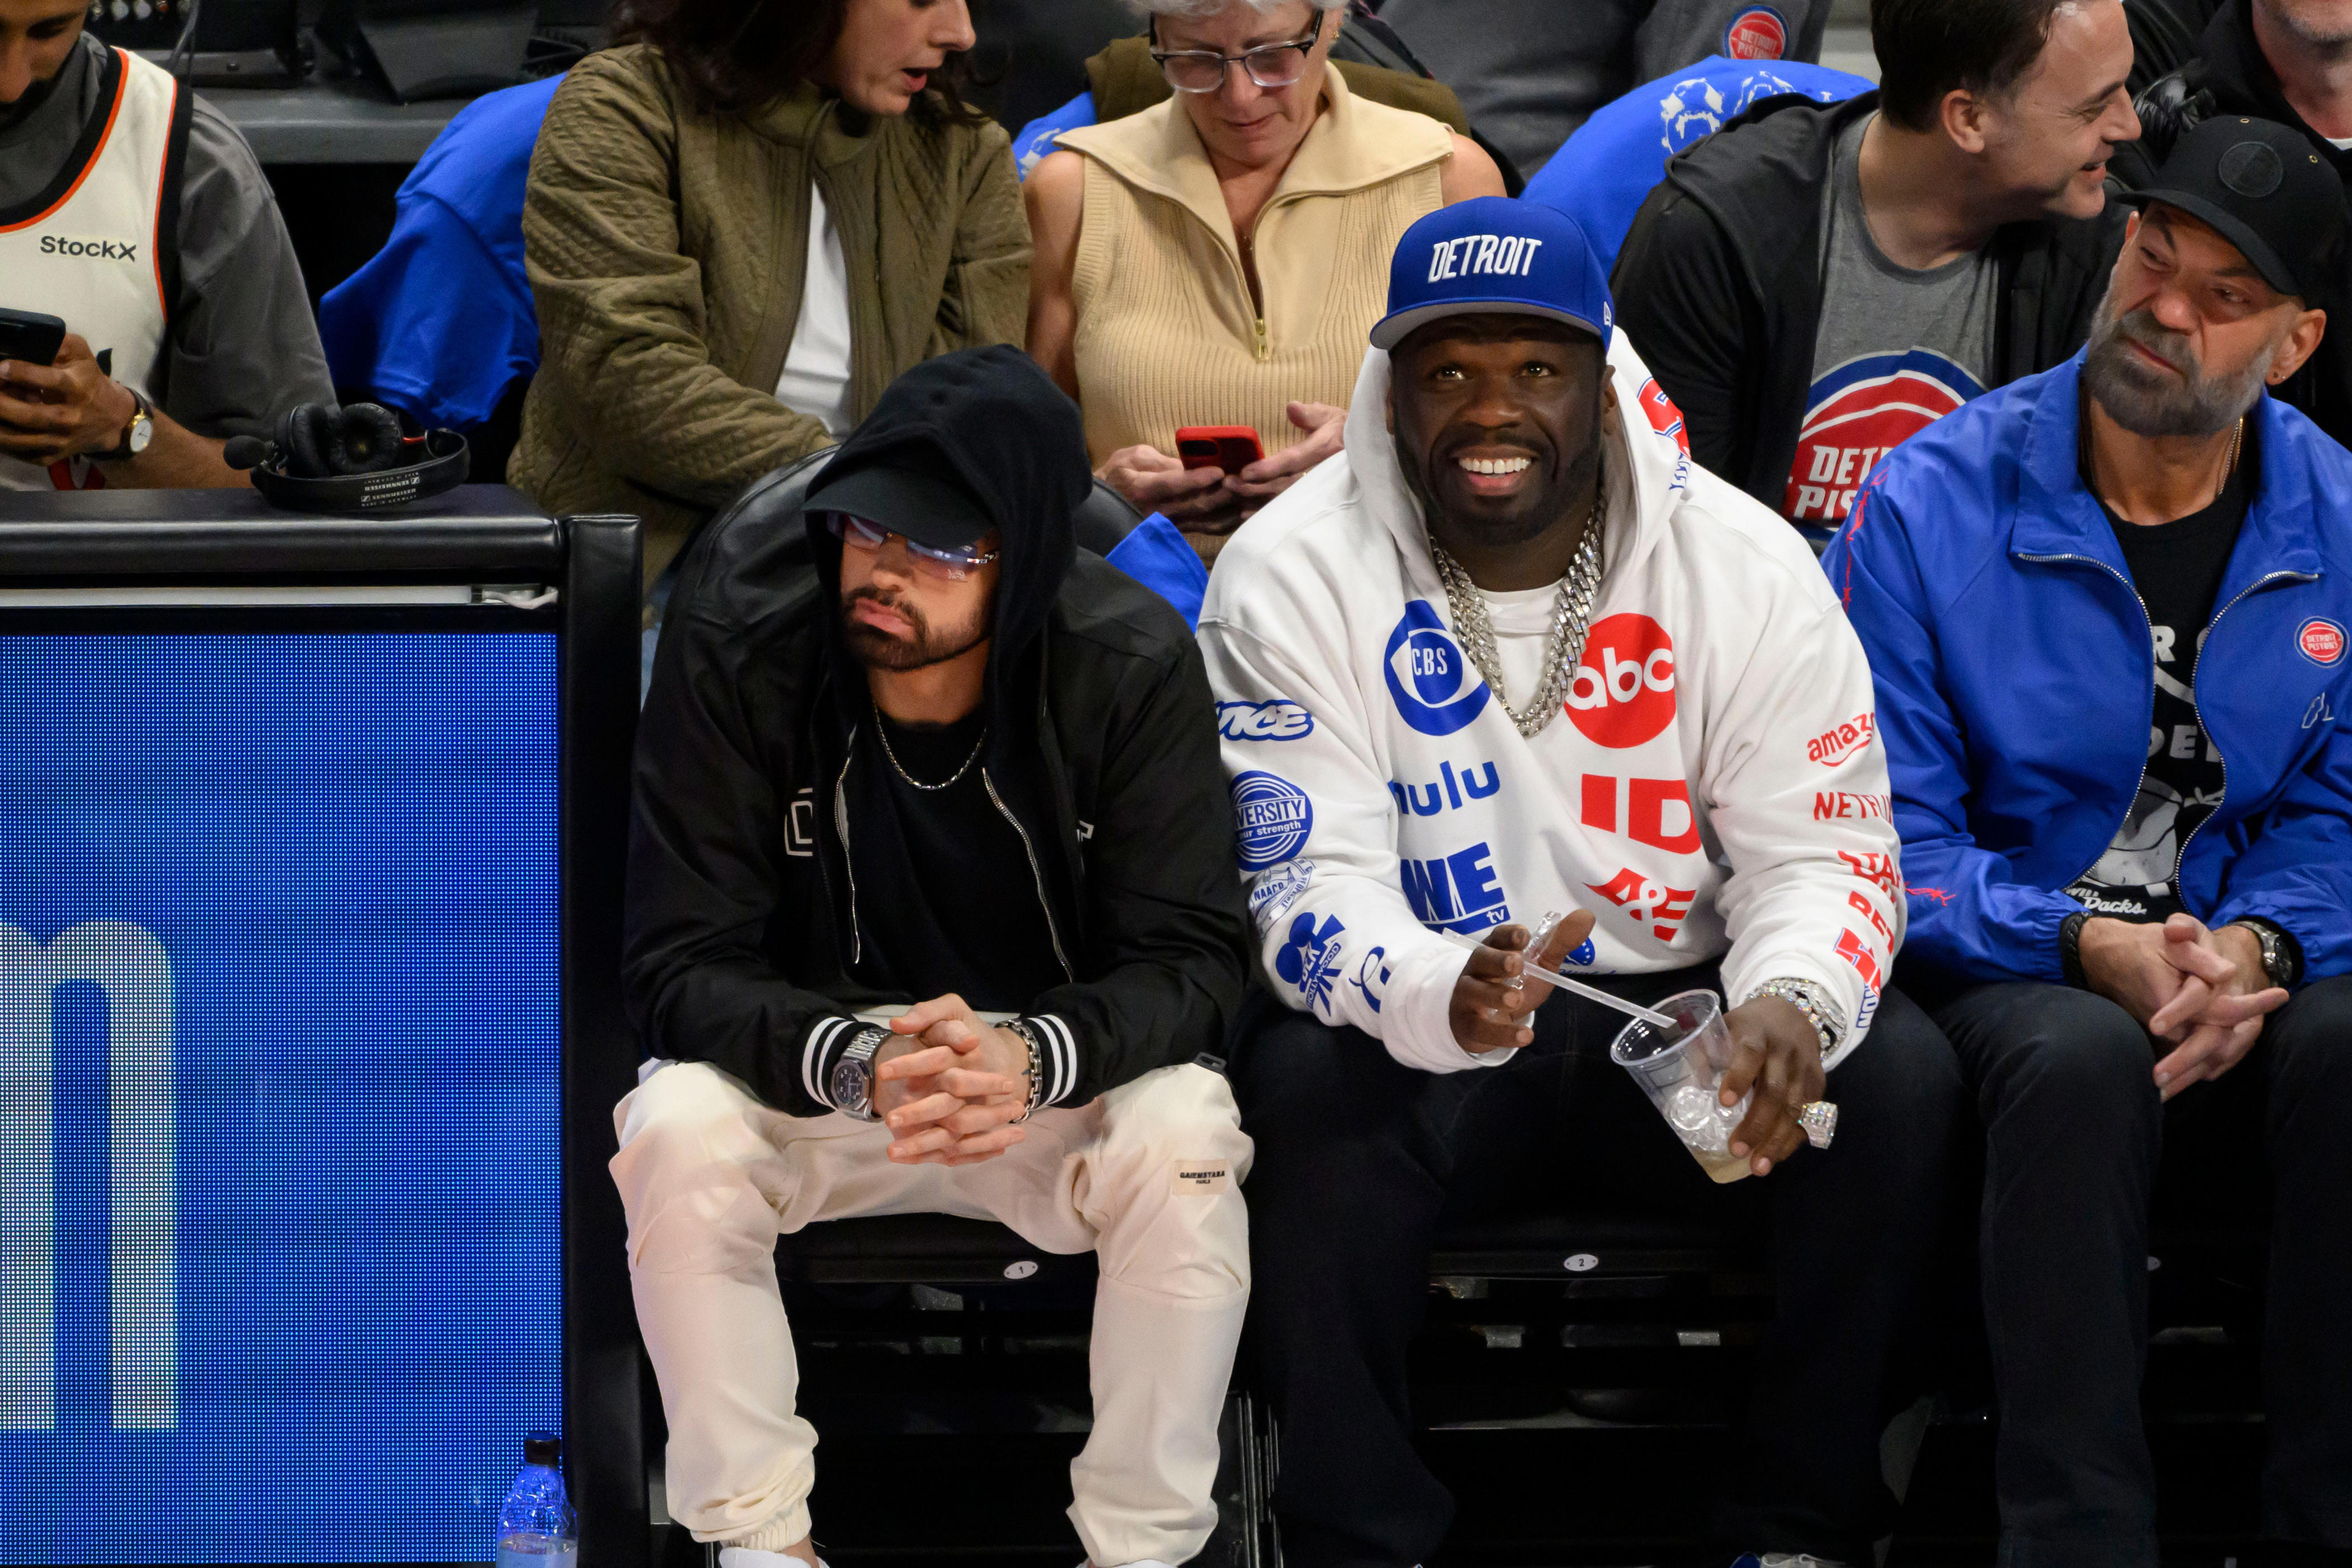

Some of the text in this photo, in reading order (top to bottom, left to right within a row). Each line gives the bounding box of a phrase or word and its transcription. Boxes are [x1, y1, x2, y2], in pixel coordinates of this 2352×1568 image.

[40, 235, 136, 262] StockX
[1428, 234, 1542, 283] DETROIT
[1808, 445, 1894, 484] DET
[1412, 648, 1447, 676] CBS
[1565, 646, 1675, 710] abc
[1257, 820, 1301, 835] strength
[1581, 773, 1702, 855] ID
[1400, 842, 1505, 922] WE
[1486, 909, 1504, 924] tv
[1582, 867, 1697, 942] A&E
[1306, 944, 1340, 1009] HOLLYWOOD
[1019, 1265, 1024, 1274] 1
[1579, 1258, 1585, 1267] 2
